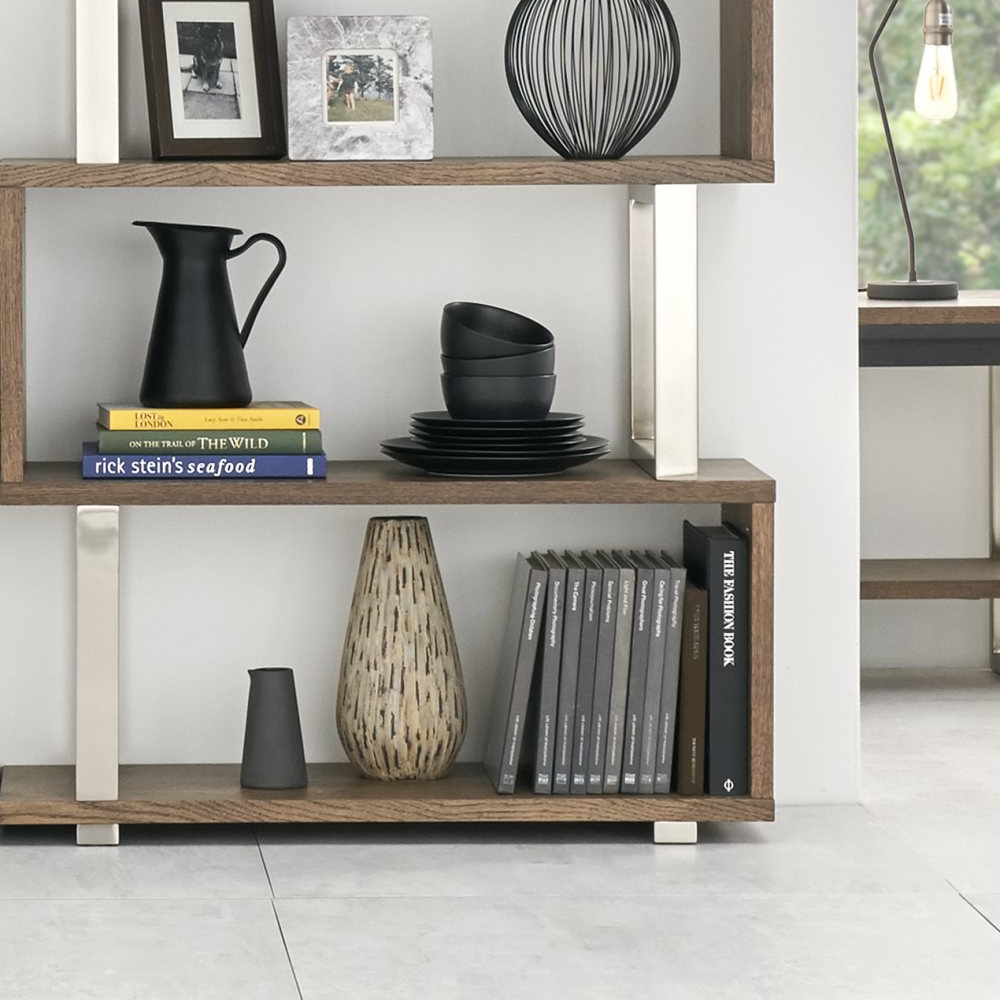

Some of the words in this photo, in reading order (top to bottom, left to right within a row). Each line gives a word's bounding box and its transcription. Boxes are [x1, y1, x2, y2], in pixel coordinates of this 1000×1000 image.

[135, 412, 156, 420] LOST
[135, 420, 173, 428] LONDON
[129, 440, 142, 448] ON
[143, 440, 160, 448] THE
[161, 440, 184, 448] TRAIL
[185, 440, 196, 448] OF
[197, 437, 228, 449] THE
[228, 437, 269, 449] WILD
[95, 457, 126, 474] rick
[131, 456, 184, 474] stein's
[187, 458, 256, 477] seafood
[723, 550, 735, 577] THE
[723, 579, 735, 630] FASHION
[723, 632, 735, 667] BOOK
